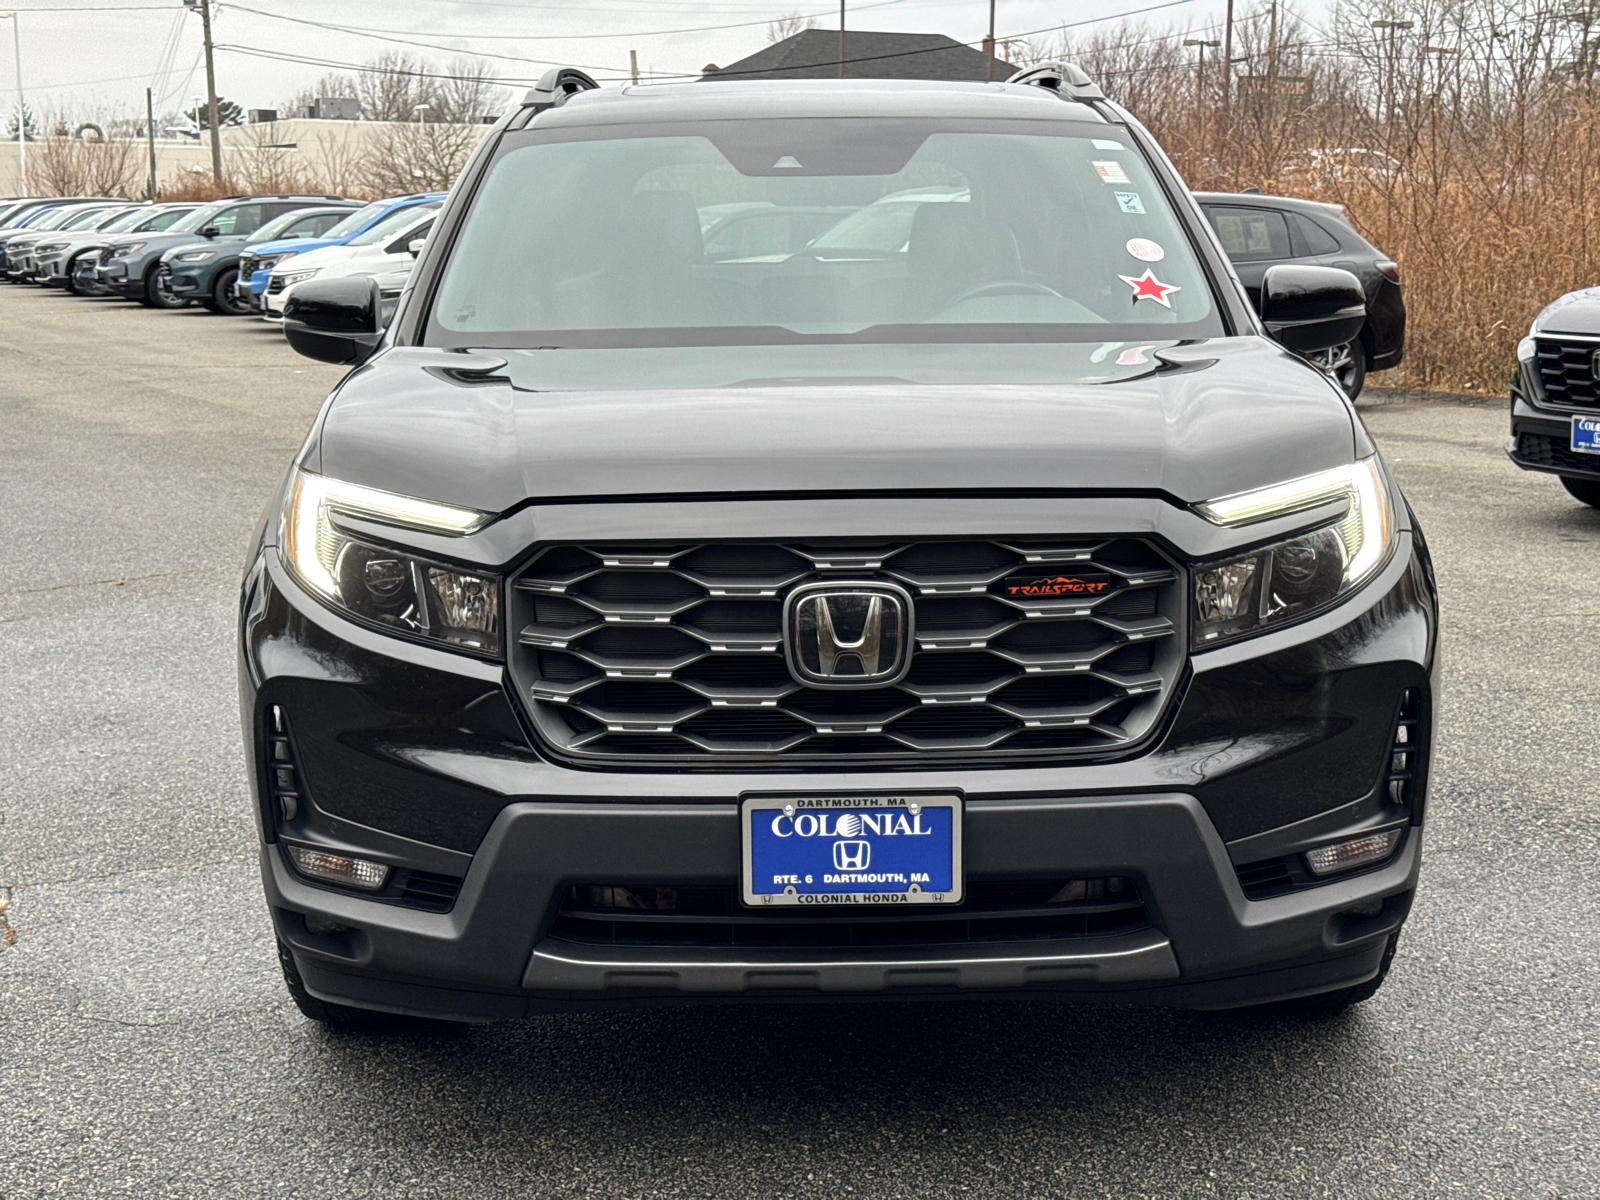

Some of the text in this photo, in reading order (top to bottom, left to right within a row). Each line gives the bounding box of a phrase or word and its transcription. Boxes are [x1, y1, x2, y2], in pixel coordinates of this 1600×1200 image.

[1008, 583, 1108, 596] TRAILSPORT
[797, 798, 906, 808] DARTMOUTH, MA
[771, 813, 932, 838] COLONIAL
[773, 873, 930, 884] RTE. 6 DARTMOUTH, MA
[797, 894, 908, 904] COLONIAL HONDA
